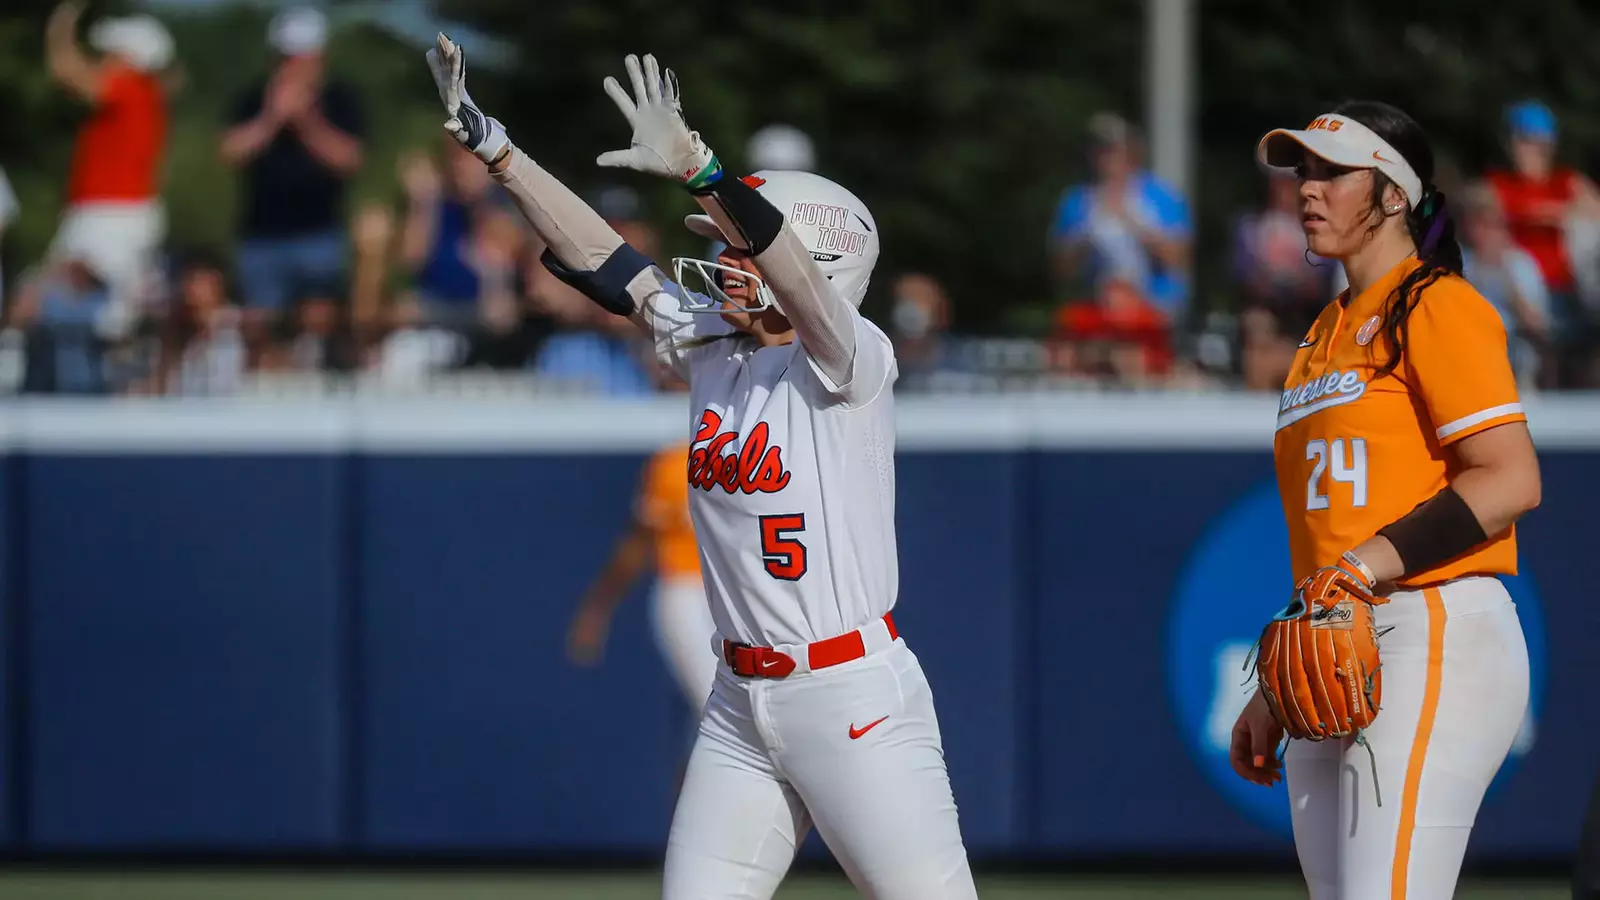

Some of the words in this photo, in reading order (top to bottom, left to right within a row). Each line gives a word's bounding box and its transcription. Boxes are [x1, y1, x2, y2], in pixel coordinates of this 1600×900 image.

[790, 202, 849, 229] HOTTY
[817, 226, 868, 257] TODDY
[1305, 437, 1368, 511] 24
[758, 513, 807, 581] 5
